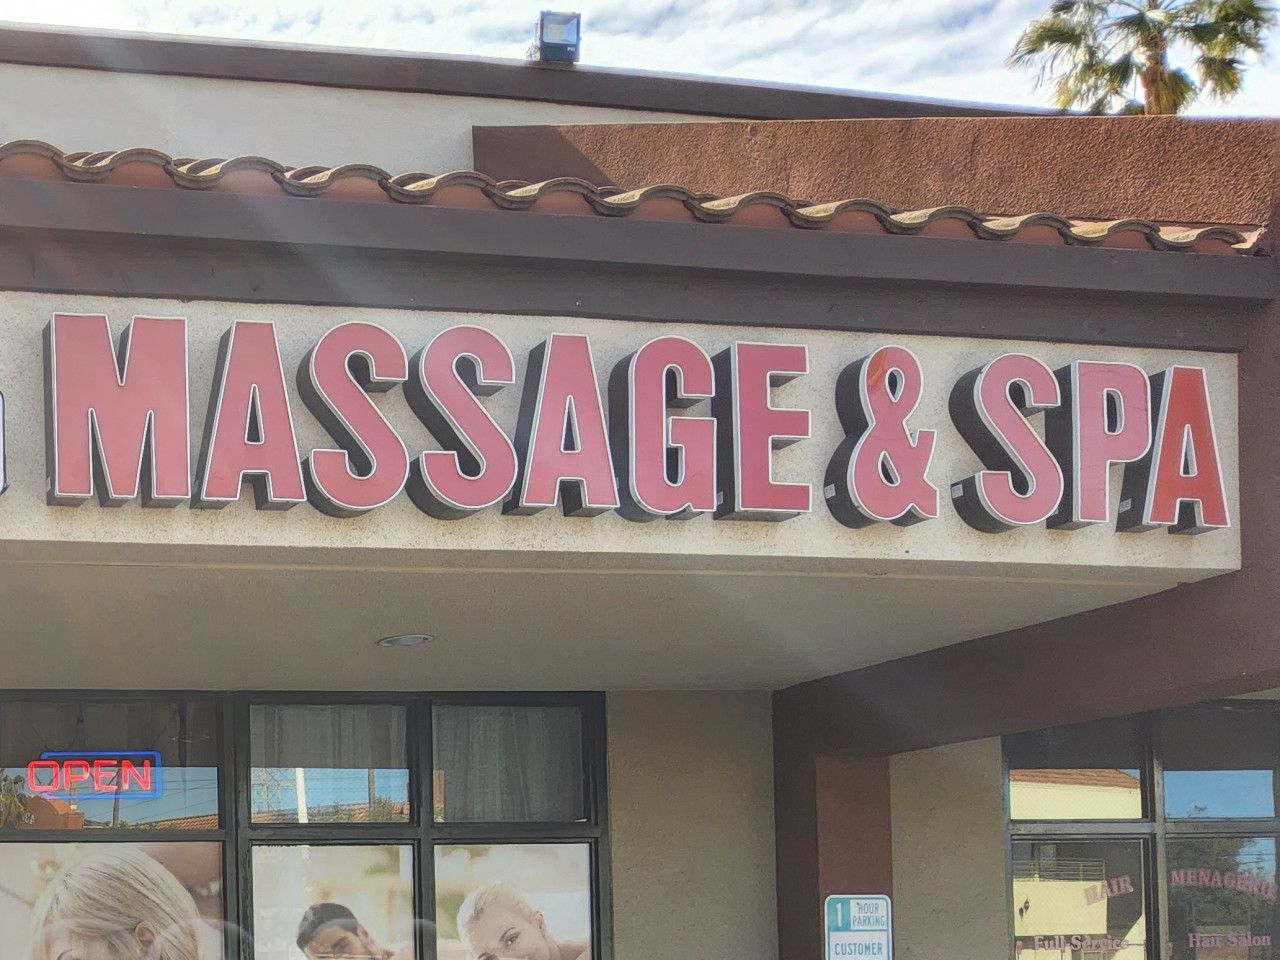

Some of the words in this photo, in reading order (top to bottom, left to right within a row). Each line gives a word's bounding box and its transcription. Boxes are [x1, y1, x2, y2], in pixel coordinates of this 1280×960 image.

[46, 311, 812, 518] MASSAGE
[828, 344, 939, 526] &
[952, 353, 1232, 530] SPA
[28, 760, 152, 792] OPEN
[836, 903, 842, 928] 1
[857, 903, 879, 914] HOUR
[853, 915, 885, 927] PARKING
[834, 943, 882, 955] CUSTOMER
[1034, 936, 1065, 952] Full
[1070, 935, 1129, 952] Service
[1188, 933, 1222, 949] Hair
[1227, 932, 1271, 947] Salon
